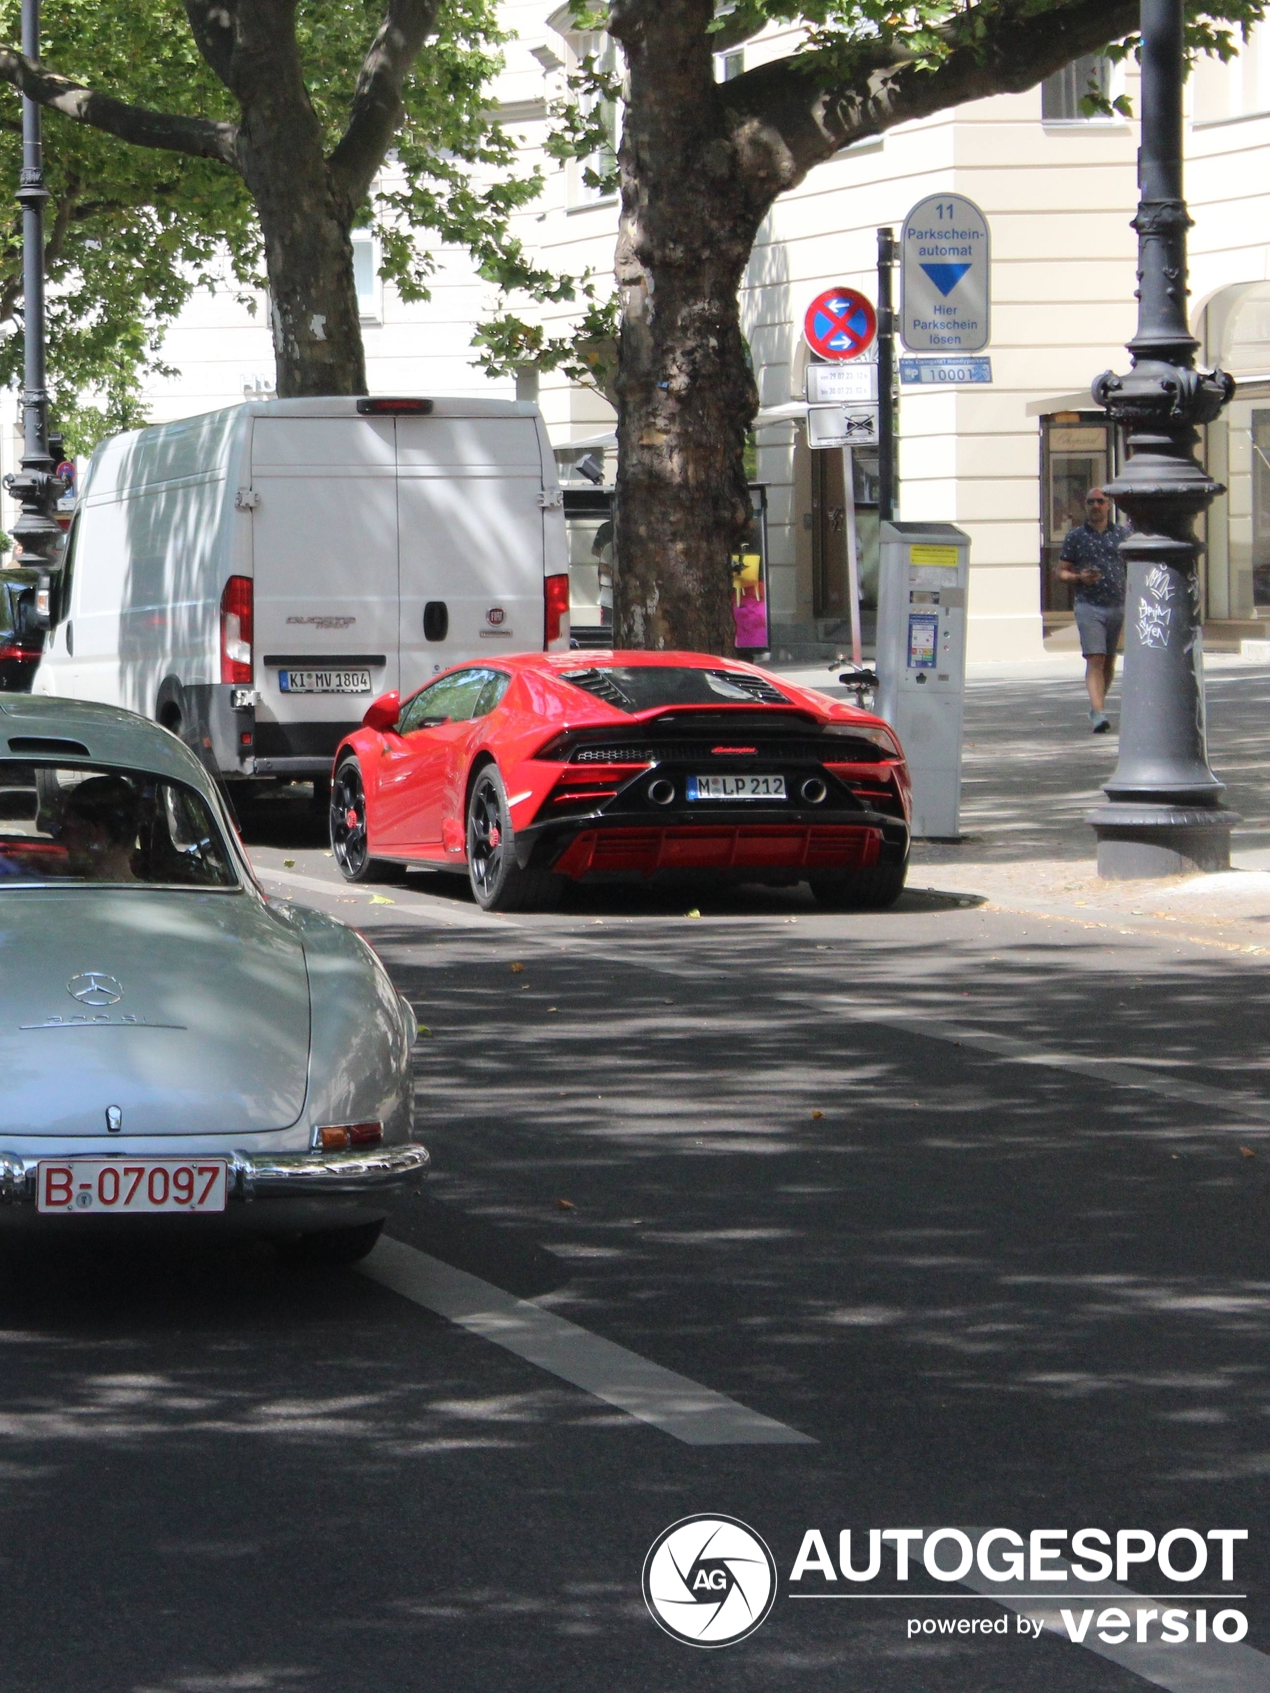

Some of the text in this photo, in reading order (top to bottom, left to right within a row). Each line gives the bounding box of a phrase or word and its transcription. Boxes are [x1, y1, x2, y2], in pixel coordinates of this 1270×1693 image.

[935, 203, 954, 220] 11
[907, 228, 984, 240] Parkschein-
[918, 245, 973, 256] automat
[933, 305, 958, 315] Hier
[912, 319, 978, 330] Parkschein
[929, 334, 961, 344] lösen
[930, 369, 973, 381] 10001
[289, 672, 368, 688] KI MV 1804
[698, 777, 784, 797] M LP 212
[44, 1166, 221, 1207] B-07097
